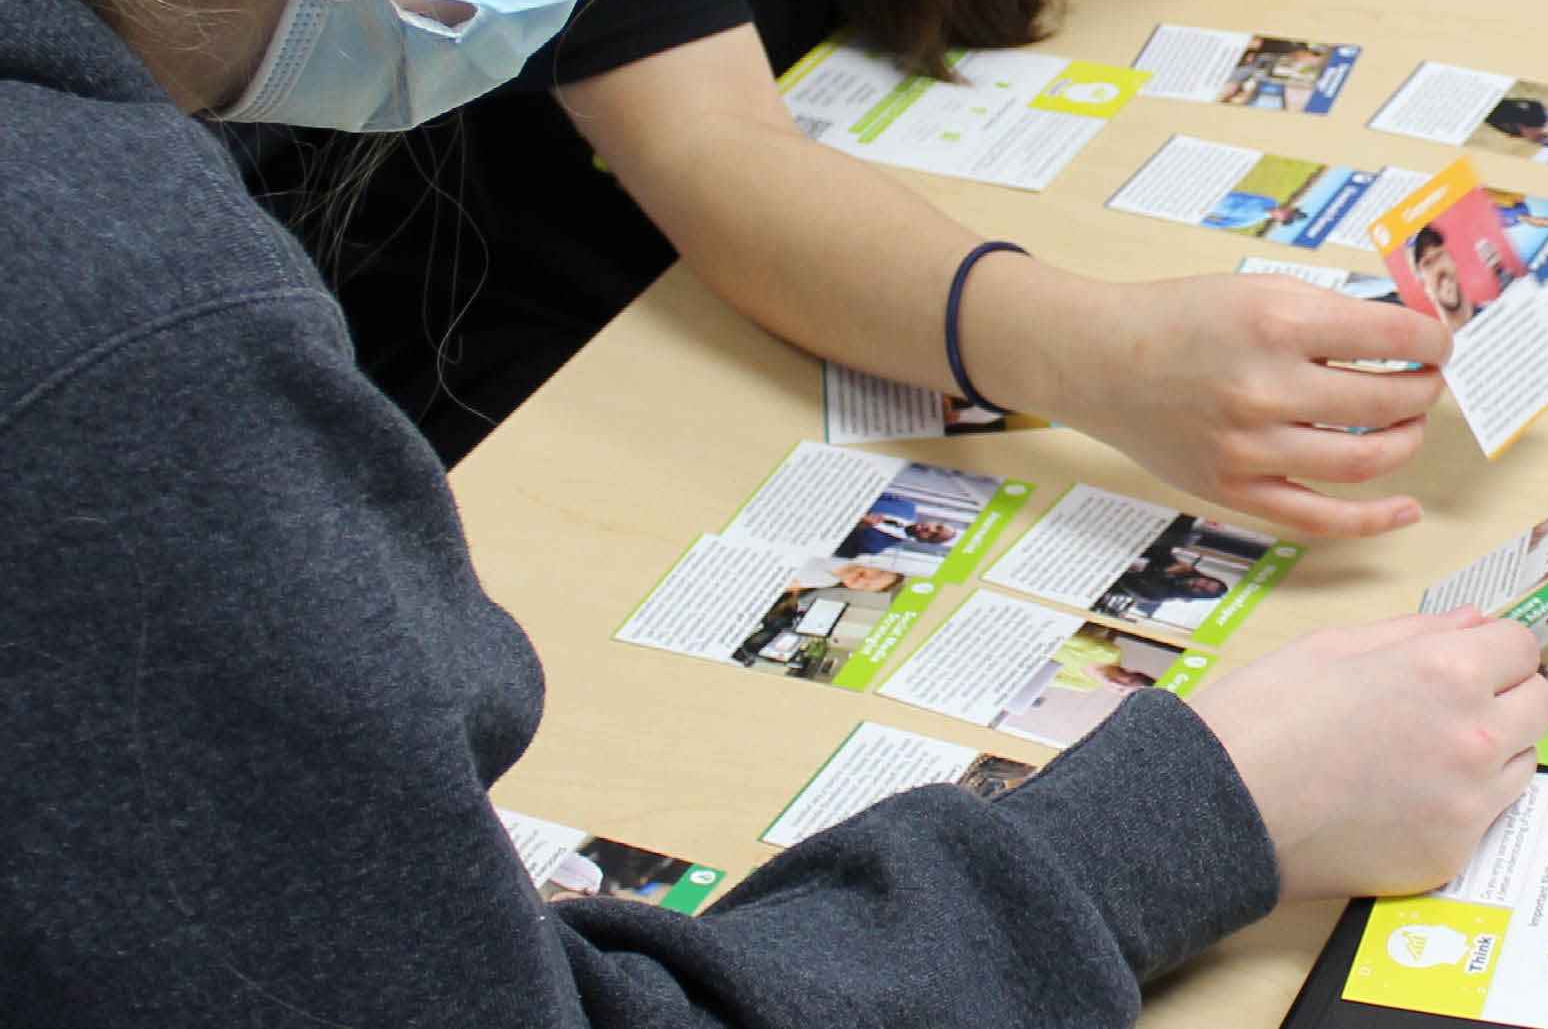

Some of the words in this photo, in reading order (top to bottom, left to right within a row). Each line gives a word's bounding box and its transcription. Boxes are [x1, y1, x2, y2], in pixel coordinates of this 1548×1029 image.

[961, 511, 1004, 555] Journalist
[889, 610, 917, 635] Social
[1211, 582, 1260, 627] Developer
[858, 612, 900, 654] Strategist
[869, 636, 897, 662] Media
[1466, 933, 1494, 973] Think
